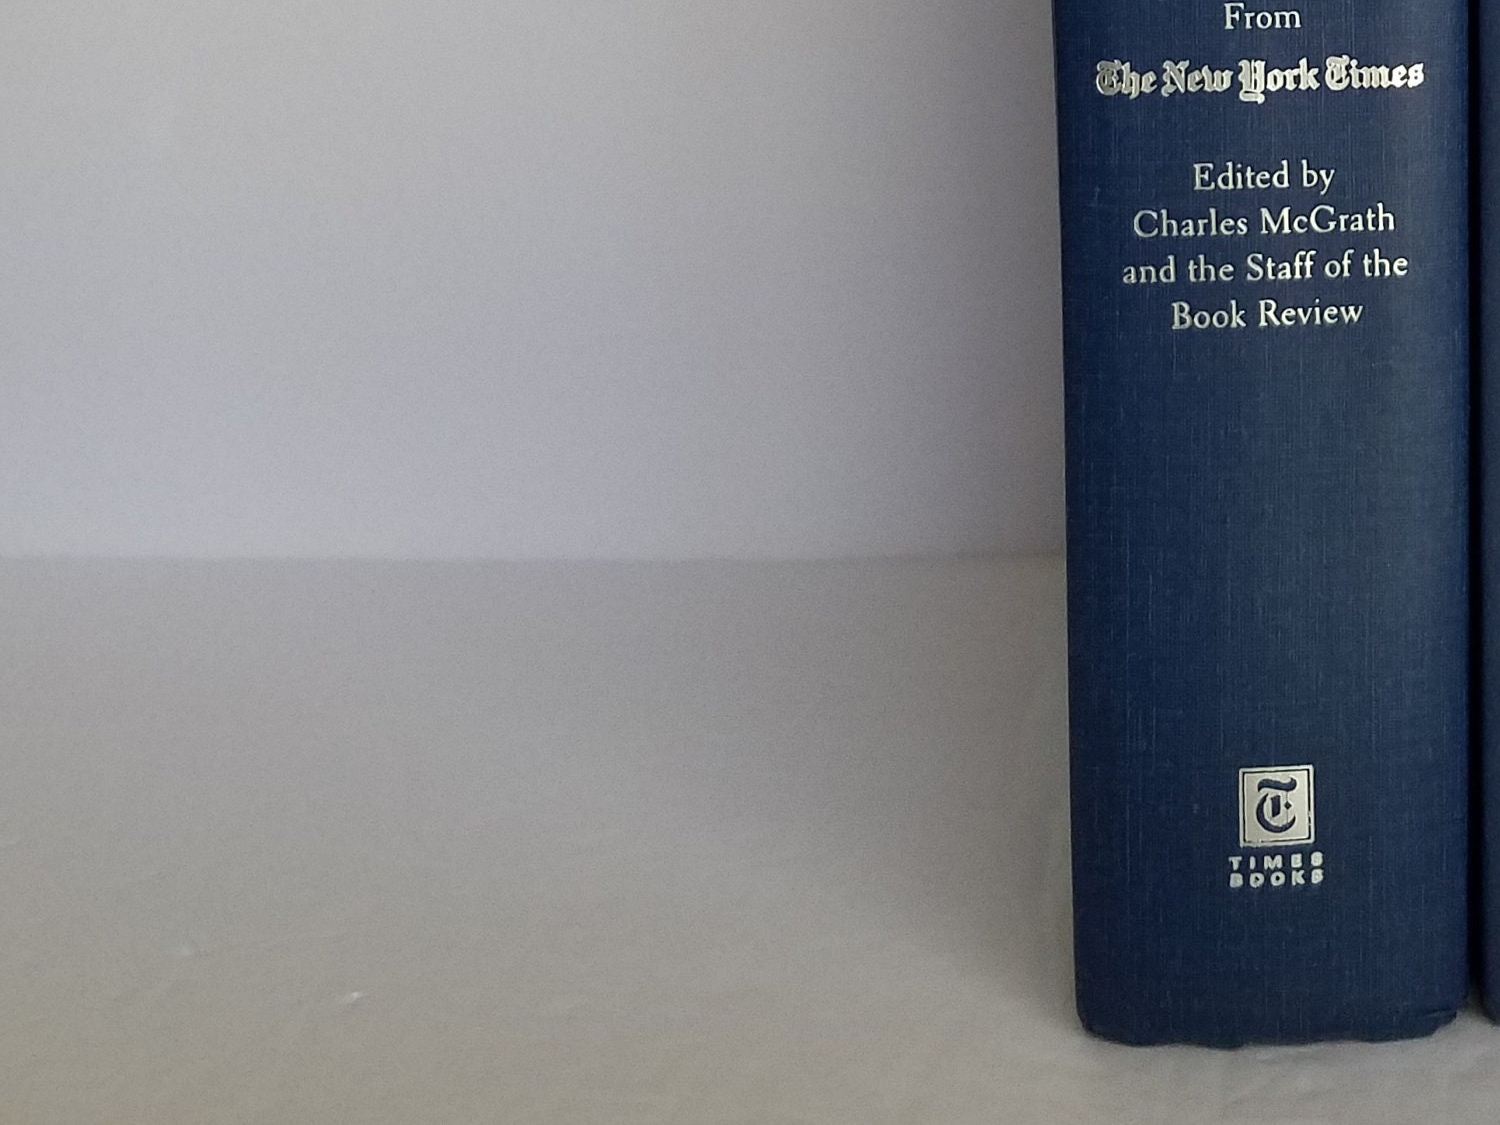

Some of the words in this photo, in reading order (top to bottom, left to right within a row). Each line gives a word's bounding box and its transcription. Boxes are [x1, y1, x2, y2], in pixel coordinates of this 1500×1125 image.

[1224, 2, 1301, 30] From
[1096, 59, 1156, 99] The
[1161, 59, 1233, 96] New
[1238, 58, 1320, 104] York
[1325, 55, 1424, 91] Times
[1193, 160, 1290, 192] Edited
[1301, 159, 1335, 194] by
[1133, 208, 1248, 238] Charles
[1260, 203, 1395, 235] McGrath
[1123, 255, 1175, 284] and
[1188, 255, 1234, 282] the
[1246, 250, 1315, 281] Staff
[1325, 249, 1355, 278] of
[1363, 249, 1409, 276] the
[1171, 300, 1247, 330] Book
[1258, 299, 1363, 326] Review
[1228, 851, 1323, 871] TIMES
[1229, 868, 1324, 888] BOOKS
